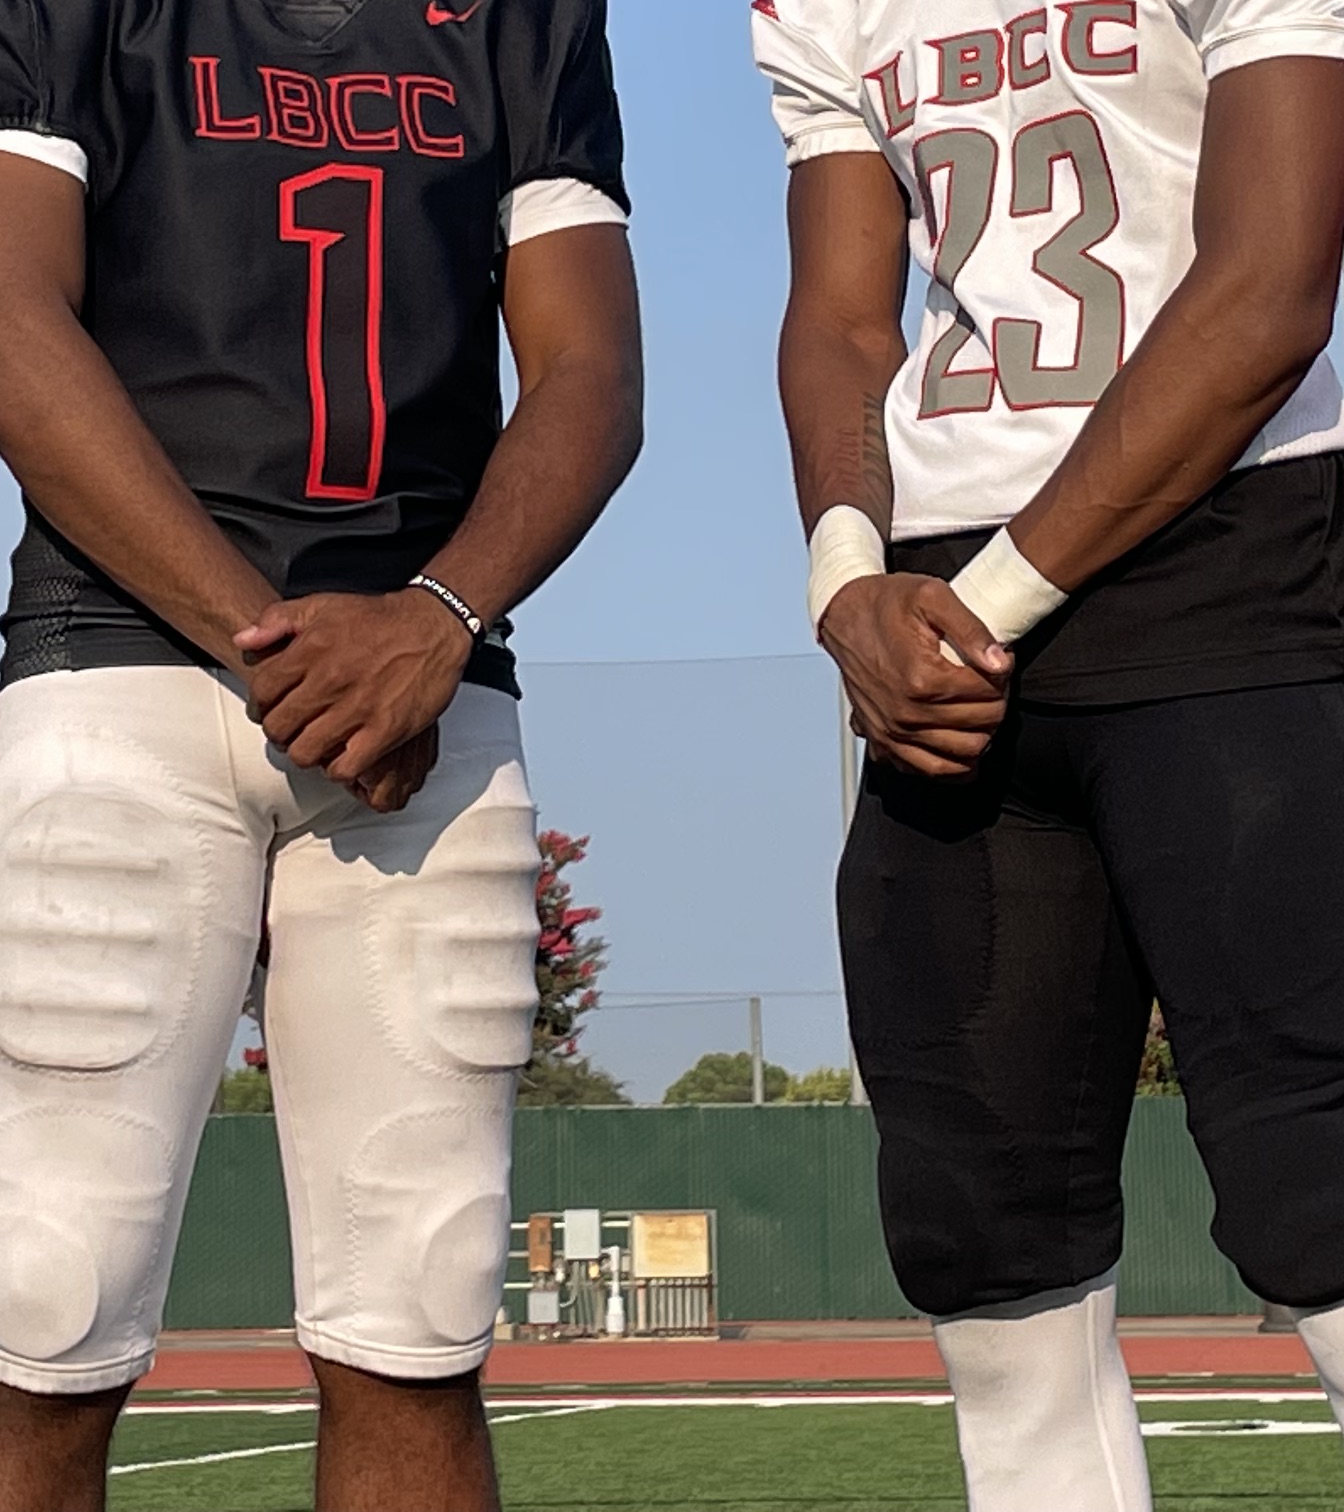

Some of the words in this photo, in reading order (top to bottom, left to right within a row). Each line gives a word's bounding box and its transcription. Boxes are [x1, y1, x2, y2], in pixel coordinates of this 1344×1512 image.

[188, 56, 464, 158] LBCC
[862, 0, 1138, 139] LBCC
[279, 162, 384, 501] 1
[912, 109, 1126, 420] 23
